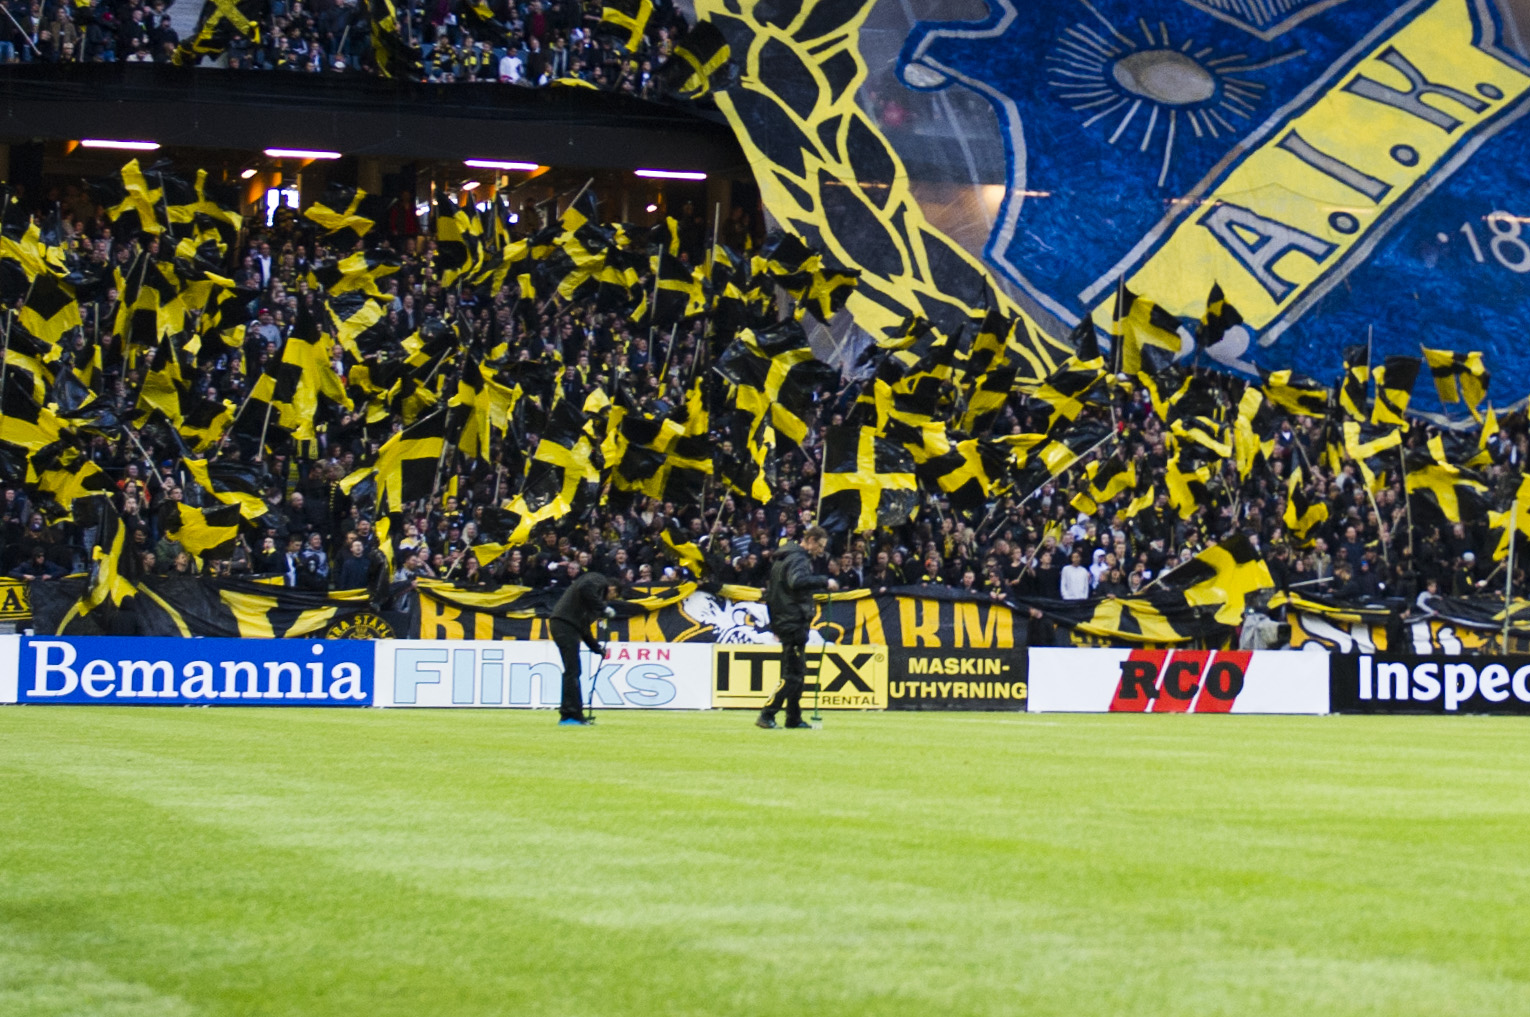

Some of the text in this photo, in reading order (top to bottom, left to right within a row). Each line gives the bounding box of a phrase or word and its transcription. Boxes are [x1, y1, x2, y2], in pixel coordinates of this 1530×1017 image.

[420, 588, 672, 642] BLK
[26, 640, 367, 700] Bemannia
[393, 647, 677, 707] Flinks
[907, 657, 1011, 676] MASKIN-
[1118, 659, 1245, 702] RCO
[821, 695, 880, 706] RENTAL
[889, 681, 1028, 700] UTHYRNING
